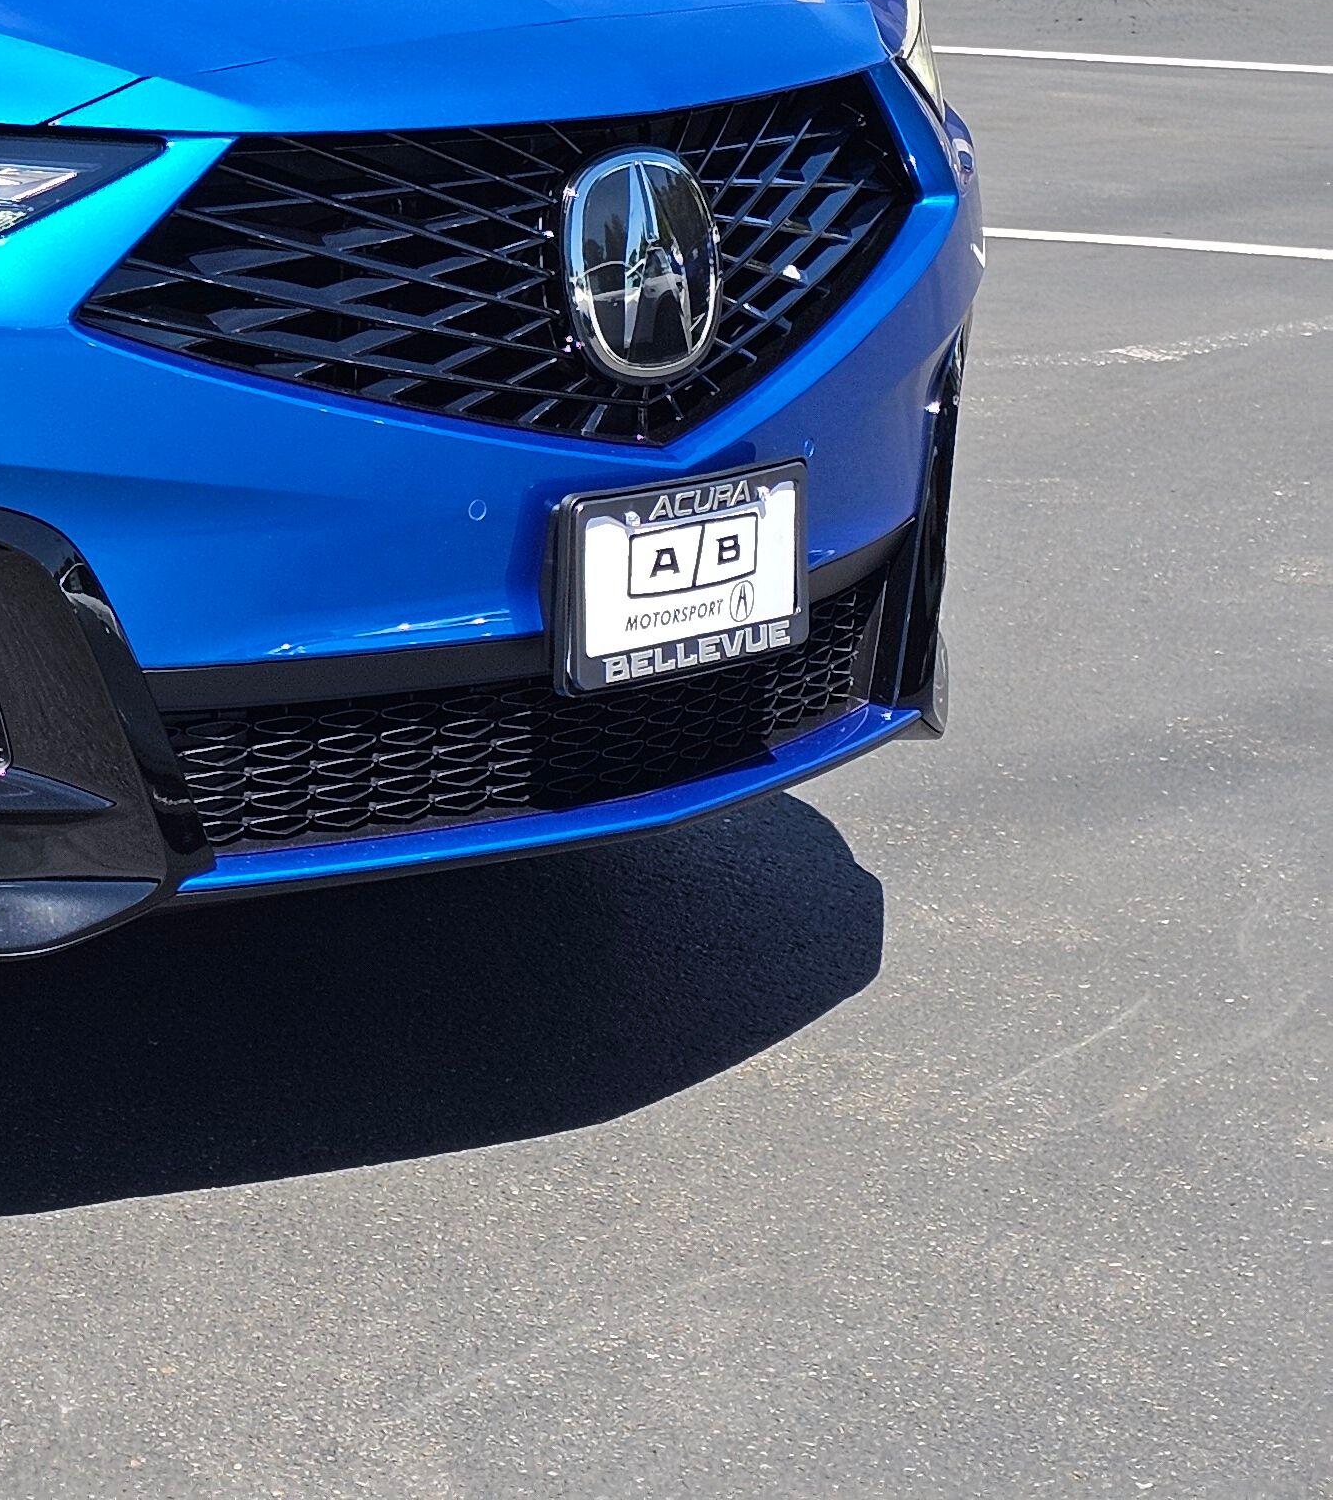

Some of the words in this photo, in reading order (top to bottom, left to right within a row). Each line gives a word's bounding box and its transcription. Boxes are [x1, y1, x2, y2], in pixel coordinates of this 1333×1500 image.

[649, 480, 751, 520] ACURA
[649, 547, 680, 578] A
[716, 534, 740, 565] B
[624, 598, 724, 632] MOTORSPORT
[601, 619, 791, 684] BELLEVUE
